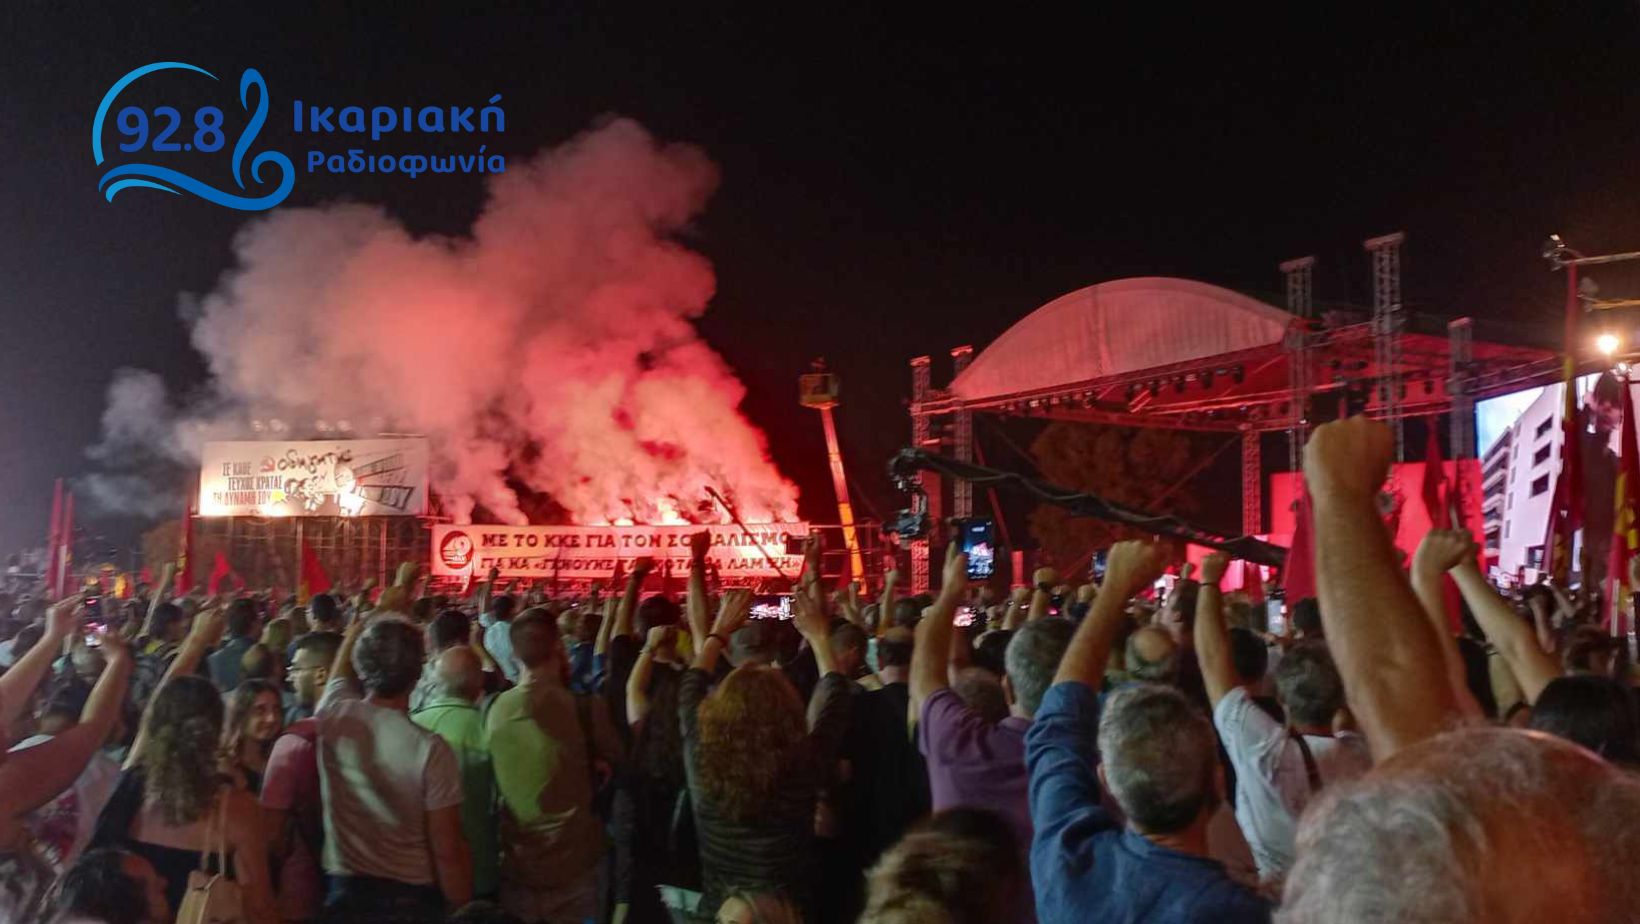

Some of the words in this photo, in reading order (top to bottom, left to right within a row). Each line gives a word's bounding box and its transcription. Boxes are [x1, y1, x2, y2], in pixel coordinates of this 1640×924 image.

[481, 533, 508, 547] ΜΕ
[514, 534, 539, 547] ΤΟ
[543, 534, 581, 548] ΚΚΕ
[585, 534, 616, 548] ΓΙΑ
[621, 534, 662, 548] ΤΟΝ
